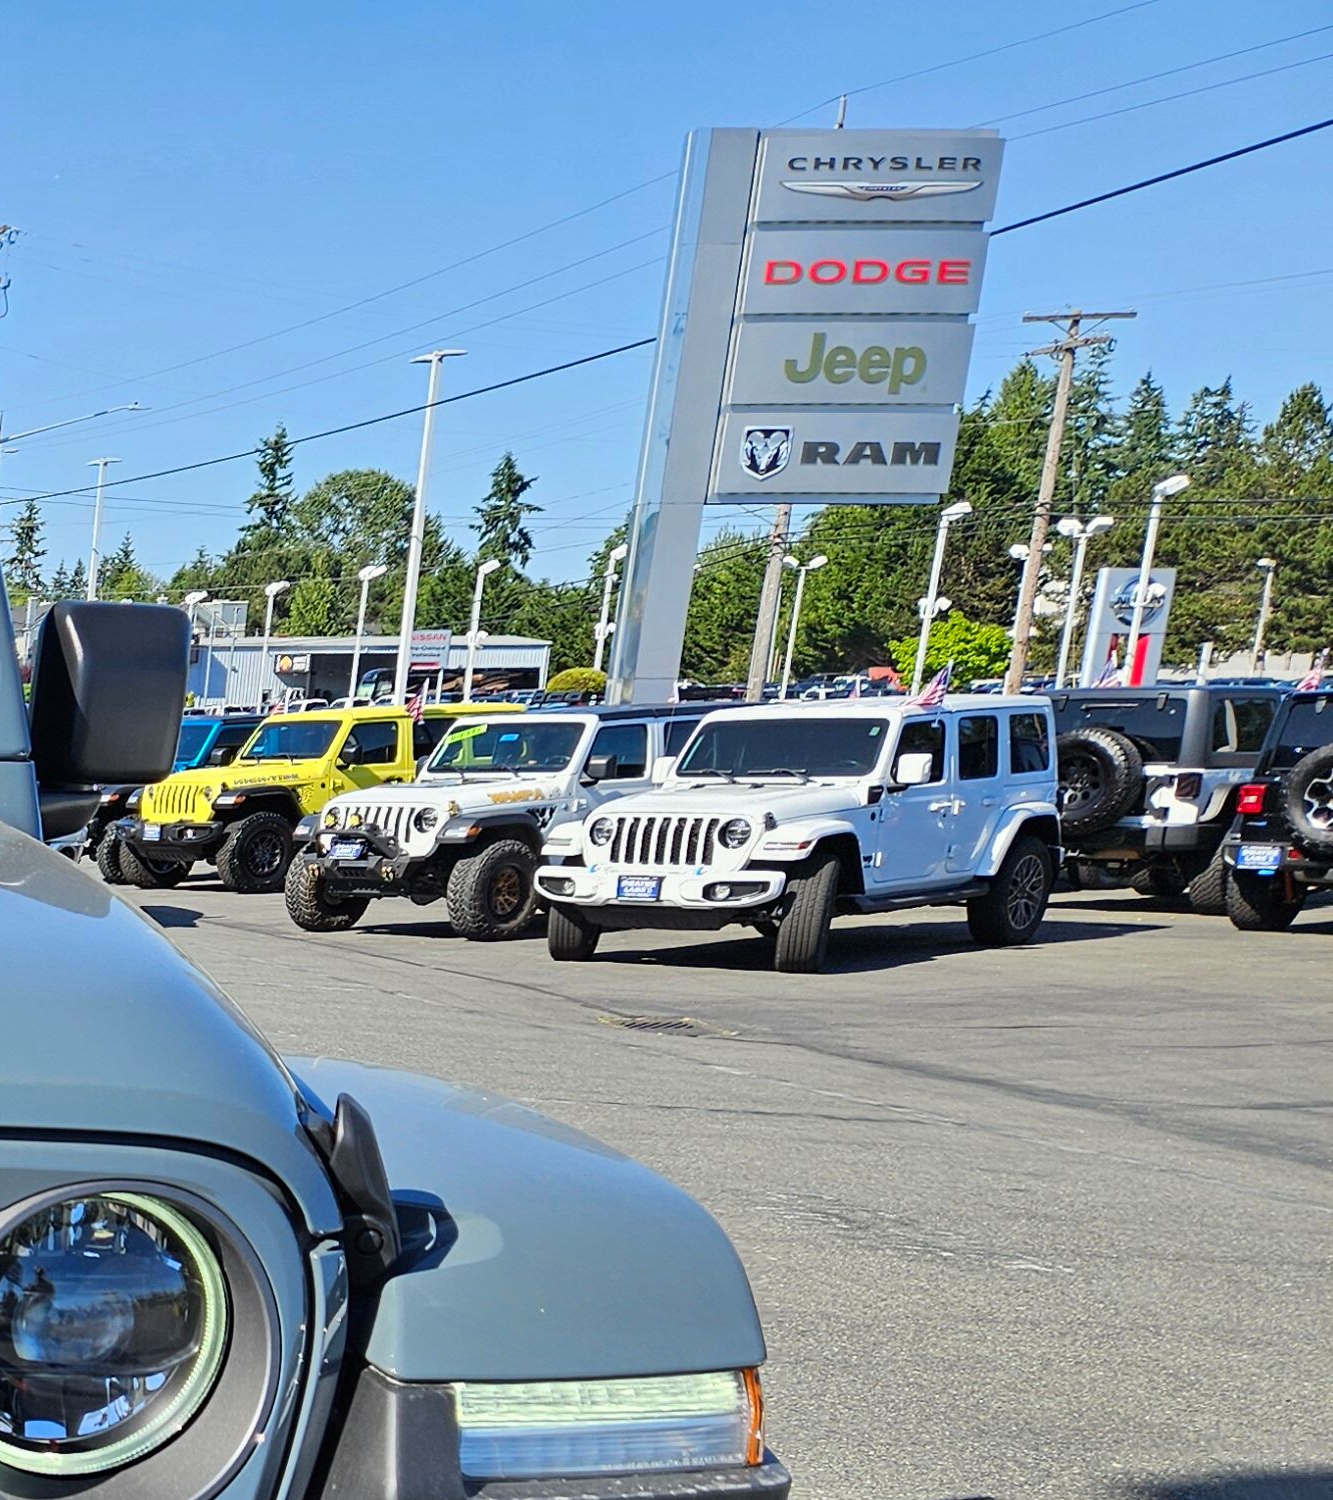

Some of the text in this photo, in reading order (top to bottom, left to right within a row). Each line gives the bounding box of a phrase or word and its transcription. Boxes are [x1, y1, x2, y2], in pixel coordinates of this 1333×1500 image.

[787, 156, 983, 172] CHRYSLER
[764, 259, 972, 286] DODGE
[783, 332, 928, 395] Jeep
[800, 441, 942, 466] RAM
